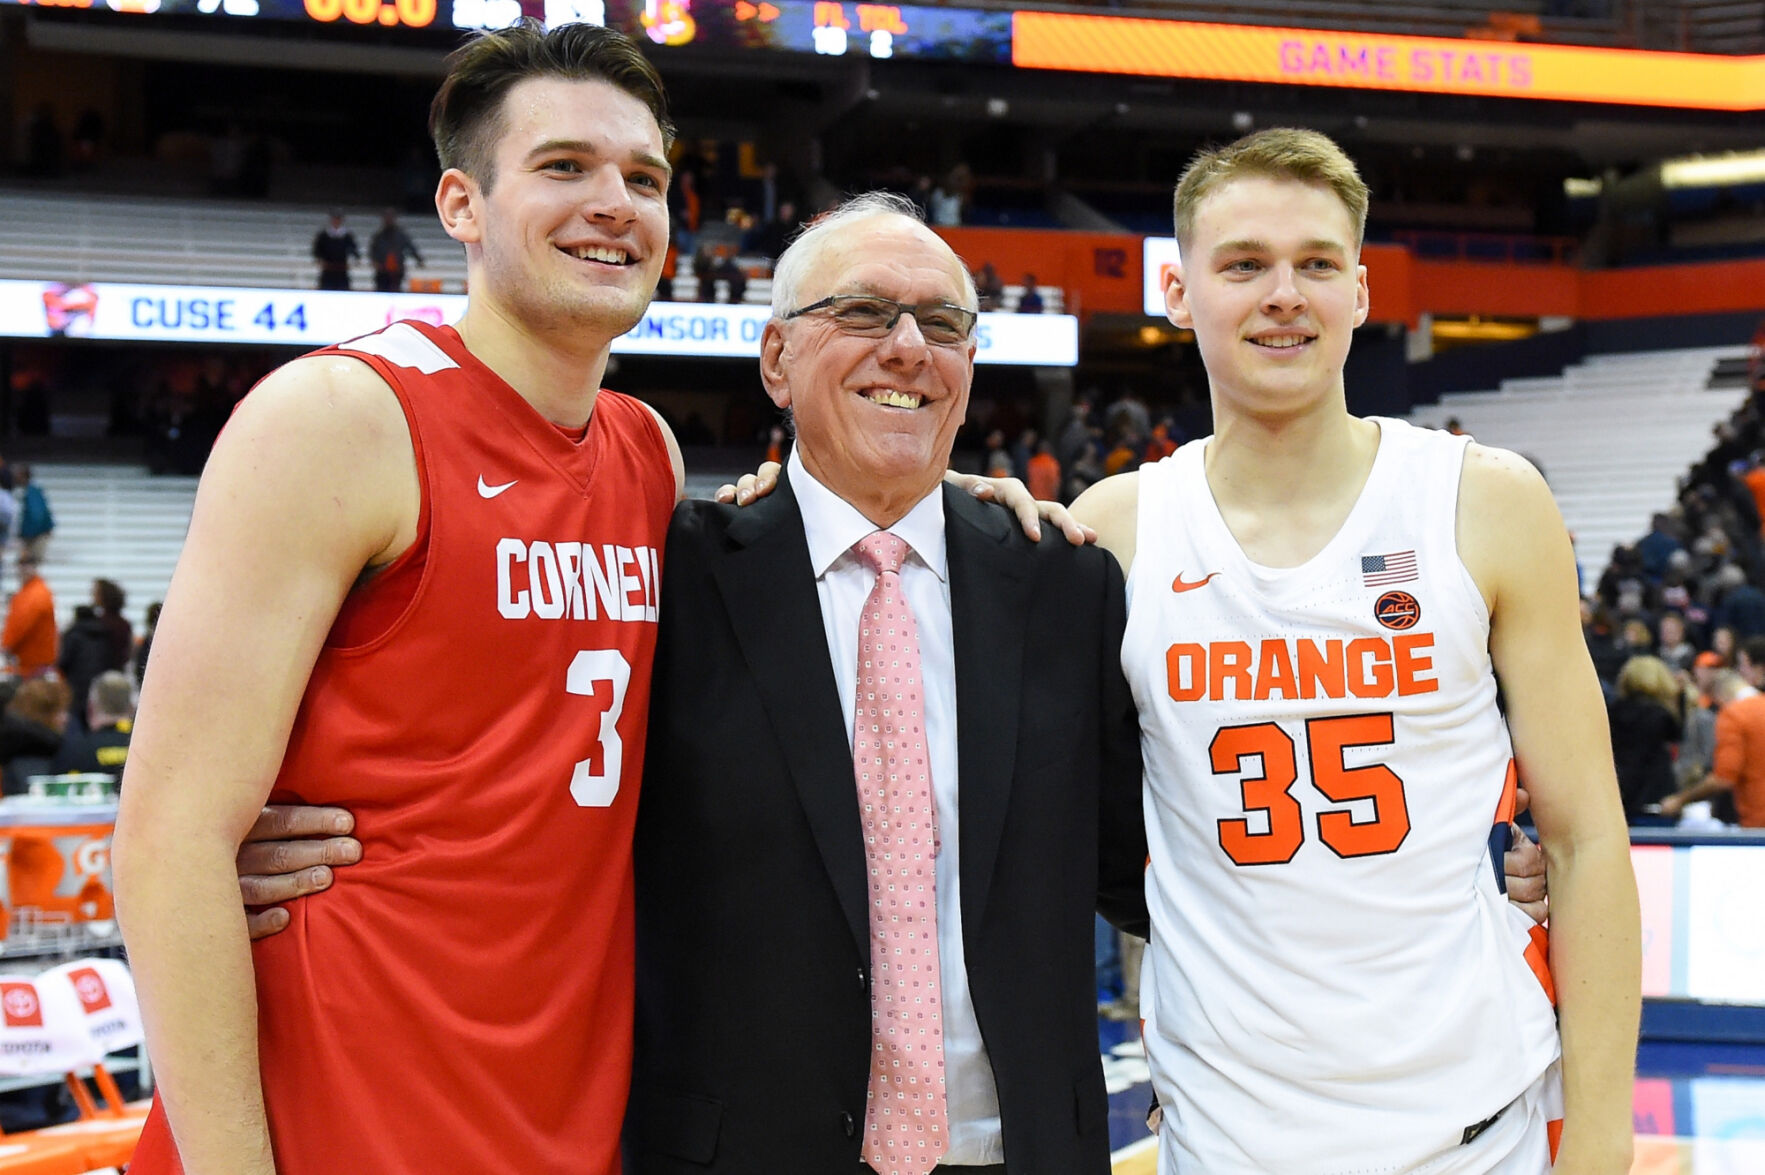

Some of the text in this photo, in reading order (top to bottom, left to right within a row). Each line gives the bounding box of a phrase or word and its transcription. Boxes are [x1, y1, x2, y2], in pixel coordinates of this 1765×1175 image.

[1281, 40, 1533, 88] GAME STATS
[131, 296, 307, 332] CUSE 44
[1382, 602, 1416, 613] ACC
[1165, 632, 1439, 702] ORANGE
[565, 649, 631, 807] 3
[1208, 711, 1411, 867] 35
